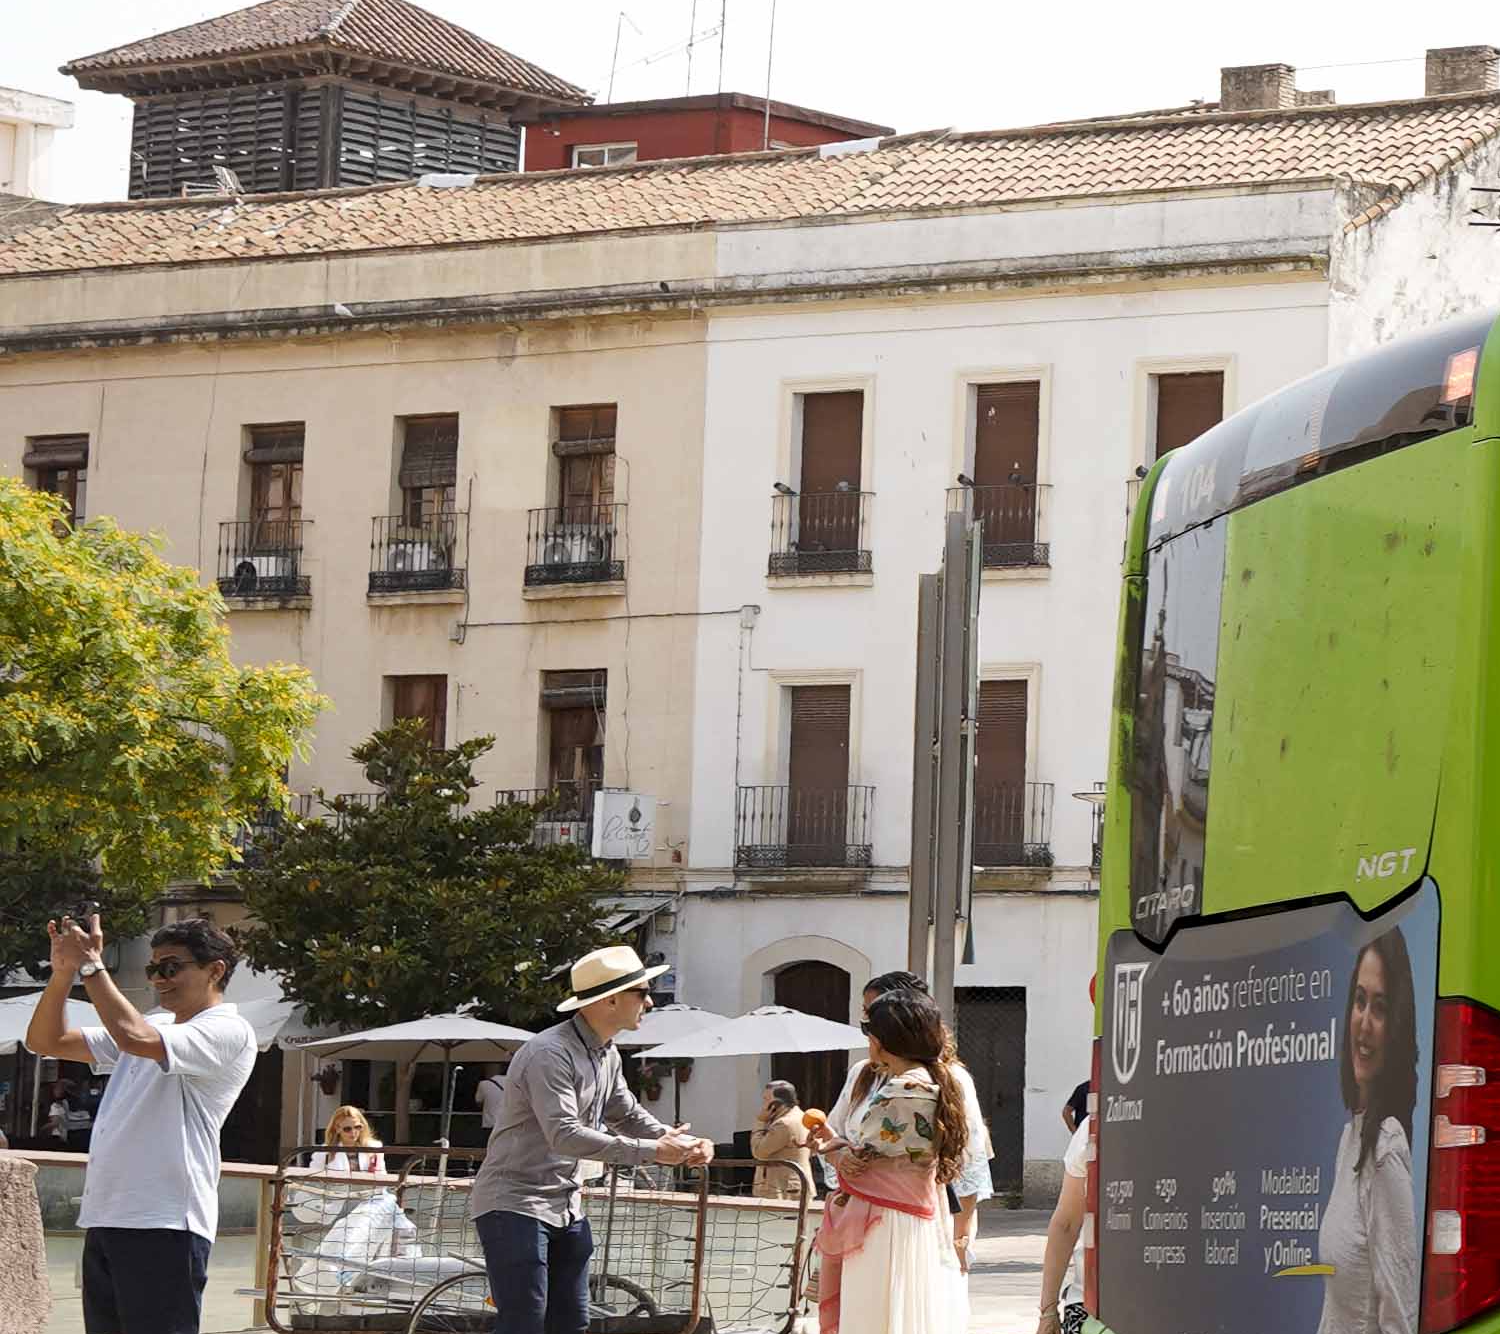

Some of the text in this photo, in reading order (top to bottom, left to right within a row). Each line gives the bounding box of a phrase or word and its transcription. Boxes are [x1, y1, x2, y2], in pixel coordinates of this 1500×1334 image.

[1357, 848, 1417, 879] NGT
[1135, 884, 1195, 919] CITARO
[1173, 979, 1191, 1016] 60
[1193, 974, 1229, 1014] años
[1232, 964, 1305, 1009] referente
[1310, 968, 1331, 1000] en
[1156, 1018, 1336, 1075] Formación Profesional
[1212, 1171, 1236, 1202] 90%
[1261, 1167, 1320, 1196] Modalidad
[1200, 1204, 1246, 1230] Inserción
[1259, 1203, 1319, 1231] Presencial
[1205, 1239, 1239, 1265] laboral
[1264, 1239, 1312, 1273] y Online
